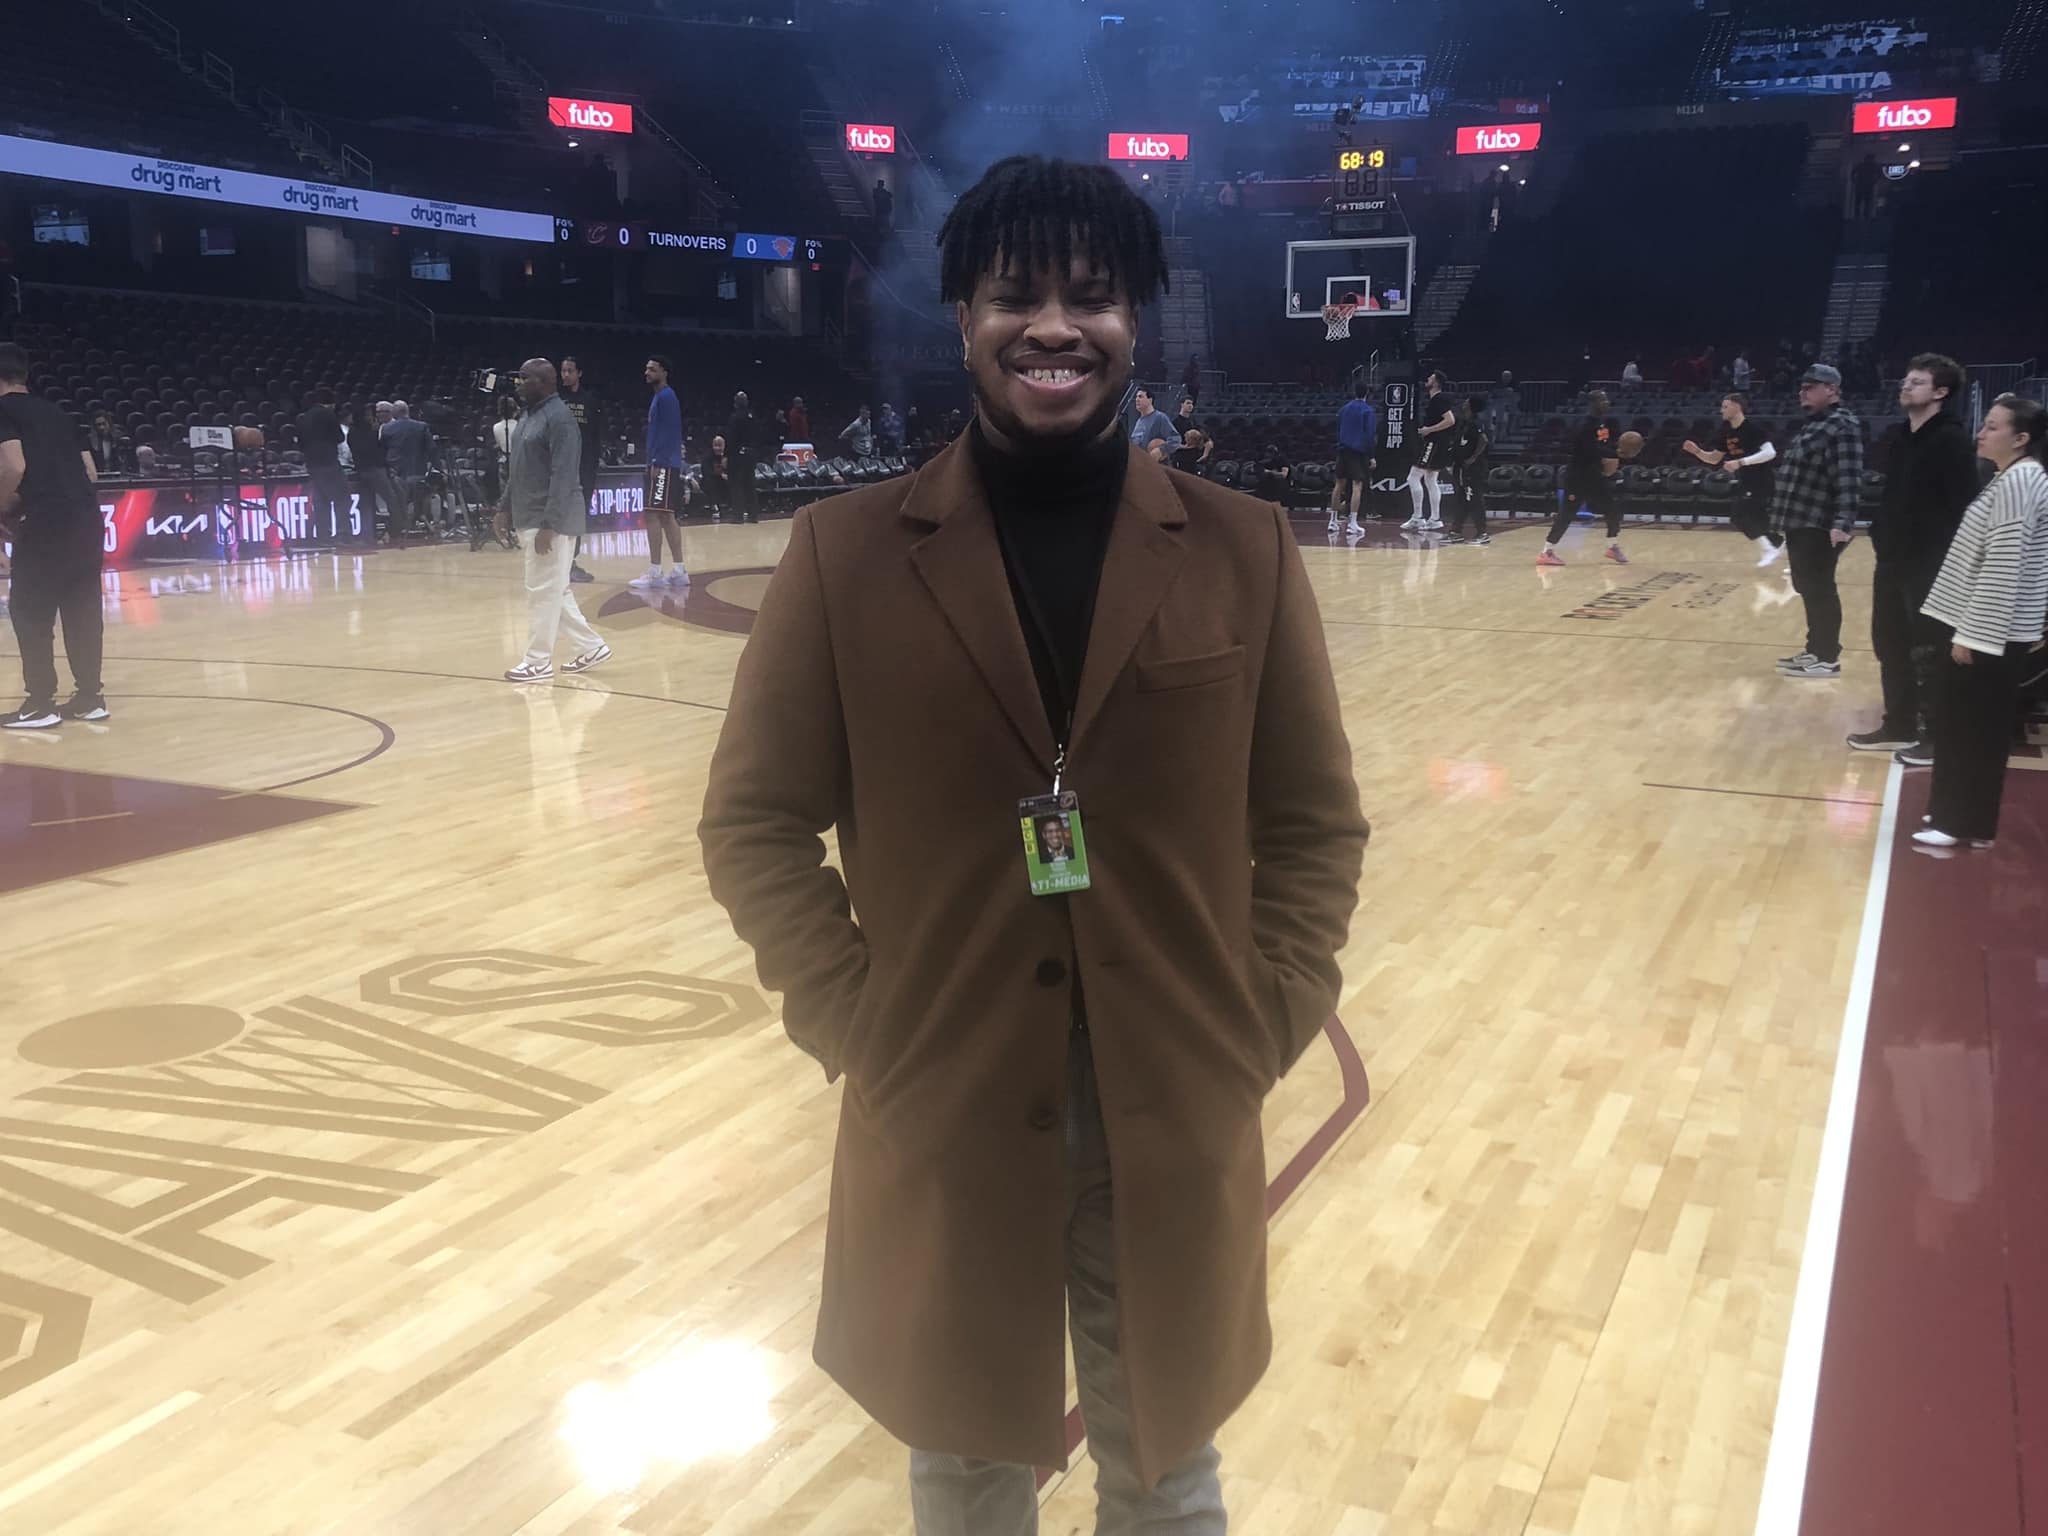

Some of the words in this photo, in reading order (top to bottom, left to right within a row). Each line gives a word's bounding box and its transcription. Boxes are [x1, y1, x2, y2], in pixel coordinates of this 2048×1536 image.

[568, 103, 612, 128] fubo
[1877, 105, 1932, 127] fubo
[850, 127, 891, 150] fubo
[1126, 136, 1170, 157] fubo
[1474, 128, 1521, 150] fubo
[1340, 150, 1384, 169] 68:19
[131, 163, 175, 192] drug
[178, 171, 222, 194] mart
[283, 185, 320, 212] drug
[323, 193, 359, 213] mart
[1349, 201, 1385, 210] TISSOT
[411, 204, 442, 228] drug
[445, 211, 478, 229] mart
[556, 217, 574, 228] FG%
[561, 229, 568, 241] 0
[619, 228, 630, 245] 0
[648, 232, 727, 251] TURNOVERS
[747, 238, 757, 255] 0
[805, 240, 823, 249] FG%
[808, 249, 815, 260] 0
[1387, 408, 1402, 420] GET
[1387, 422, 1402, 434] THE
[1386, 436, 1402, 448] APP
[654, 467, 667, 501] Knicks
[598, 488, 630, 514] TIP-OFF
